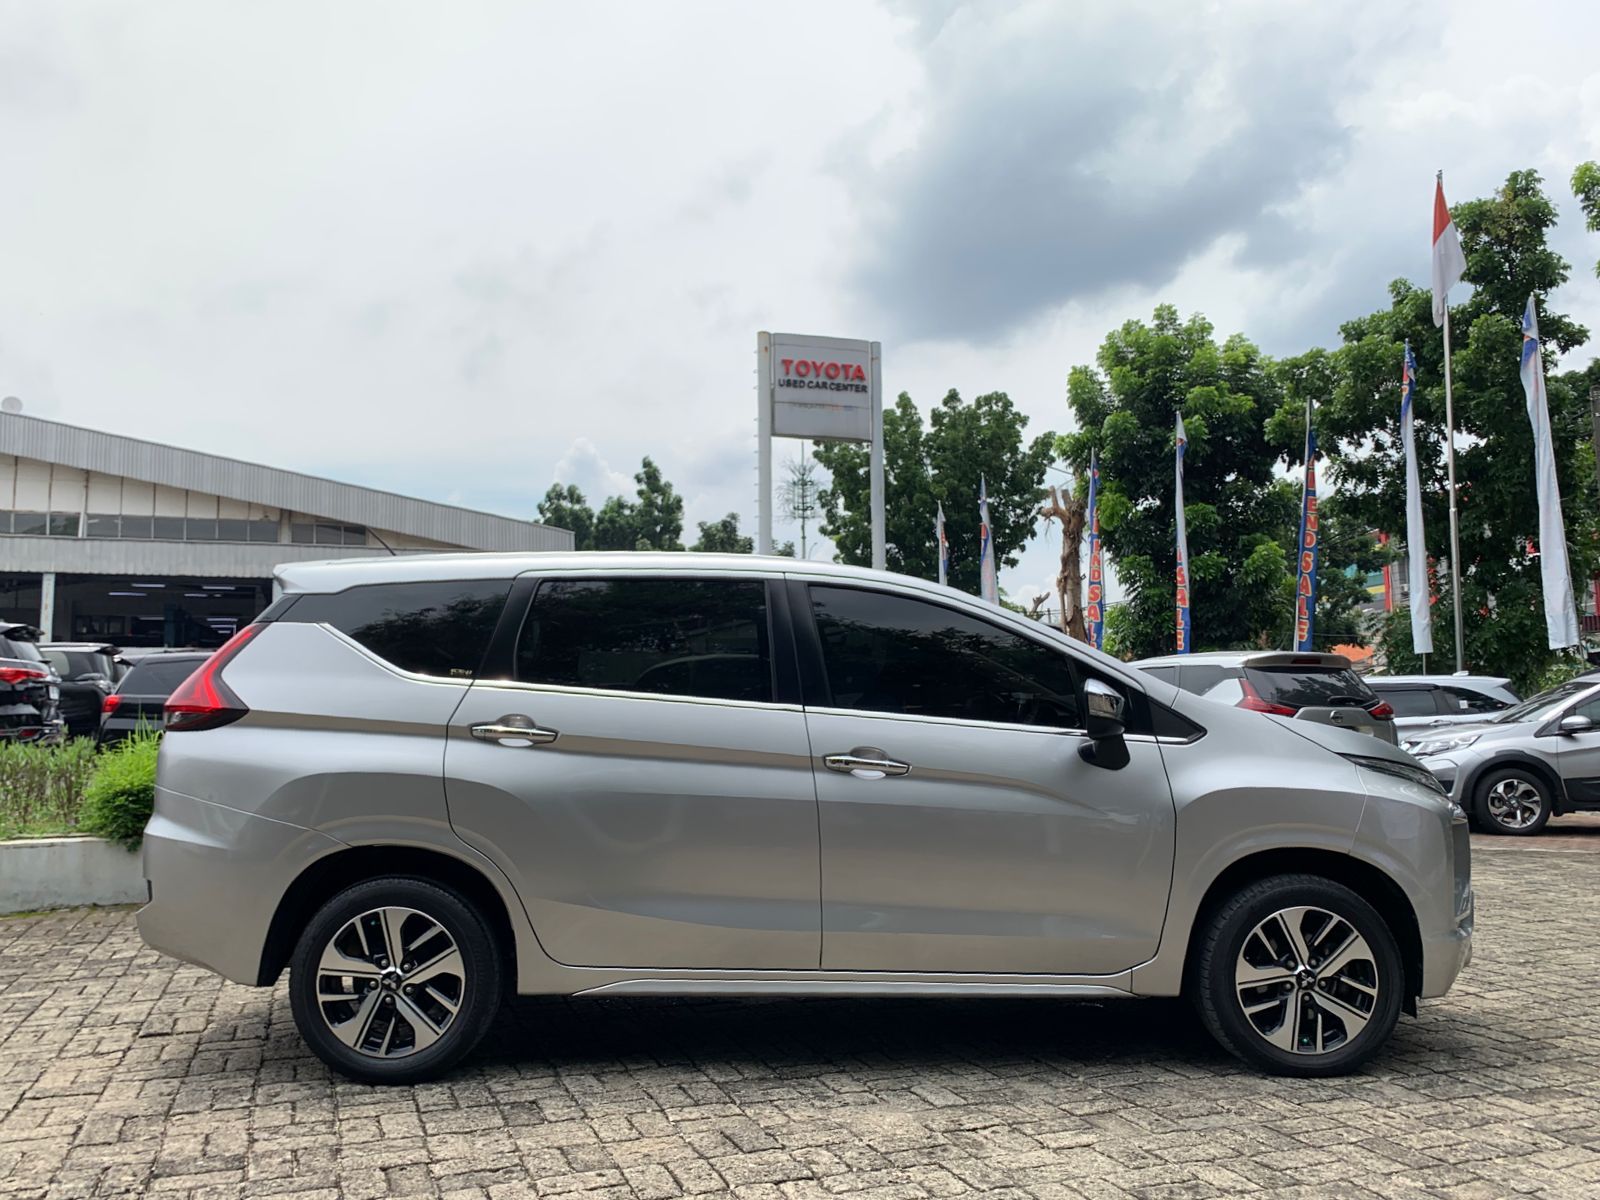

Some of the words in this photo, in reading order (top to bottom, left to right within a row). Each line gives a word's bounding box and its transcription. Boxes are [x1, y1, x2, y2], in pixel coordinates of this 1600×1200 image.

[778, 379, 806, 389] USED
[807, 381, 828, 391] CAR
[829, 383, 868, 393] CENTER
[782, 359, 866, 381] TOYOTA
[1304, 496, 1317, 548] END
[1177, 566, 1188, 651] SALE
[1298, 551, 1313, 642] SALE
